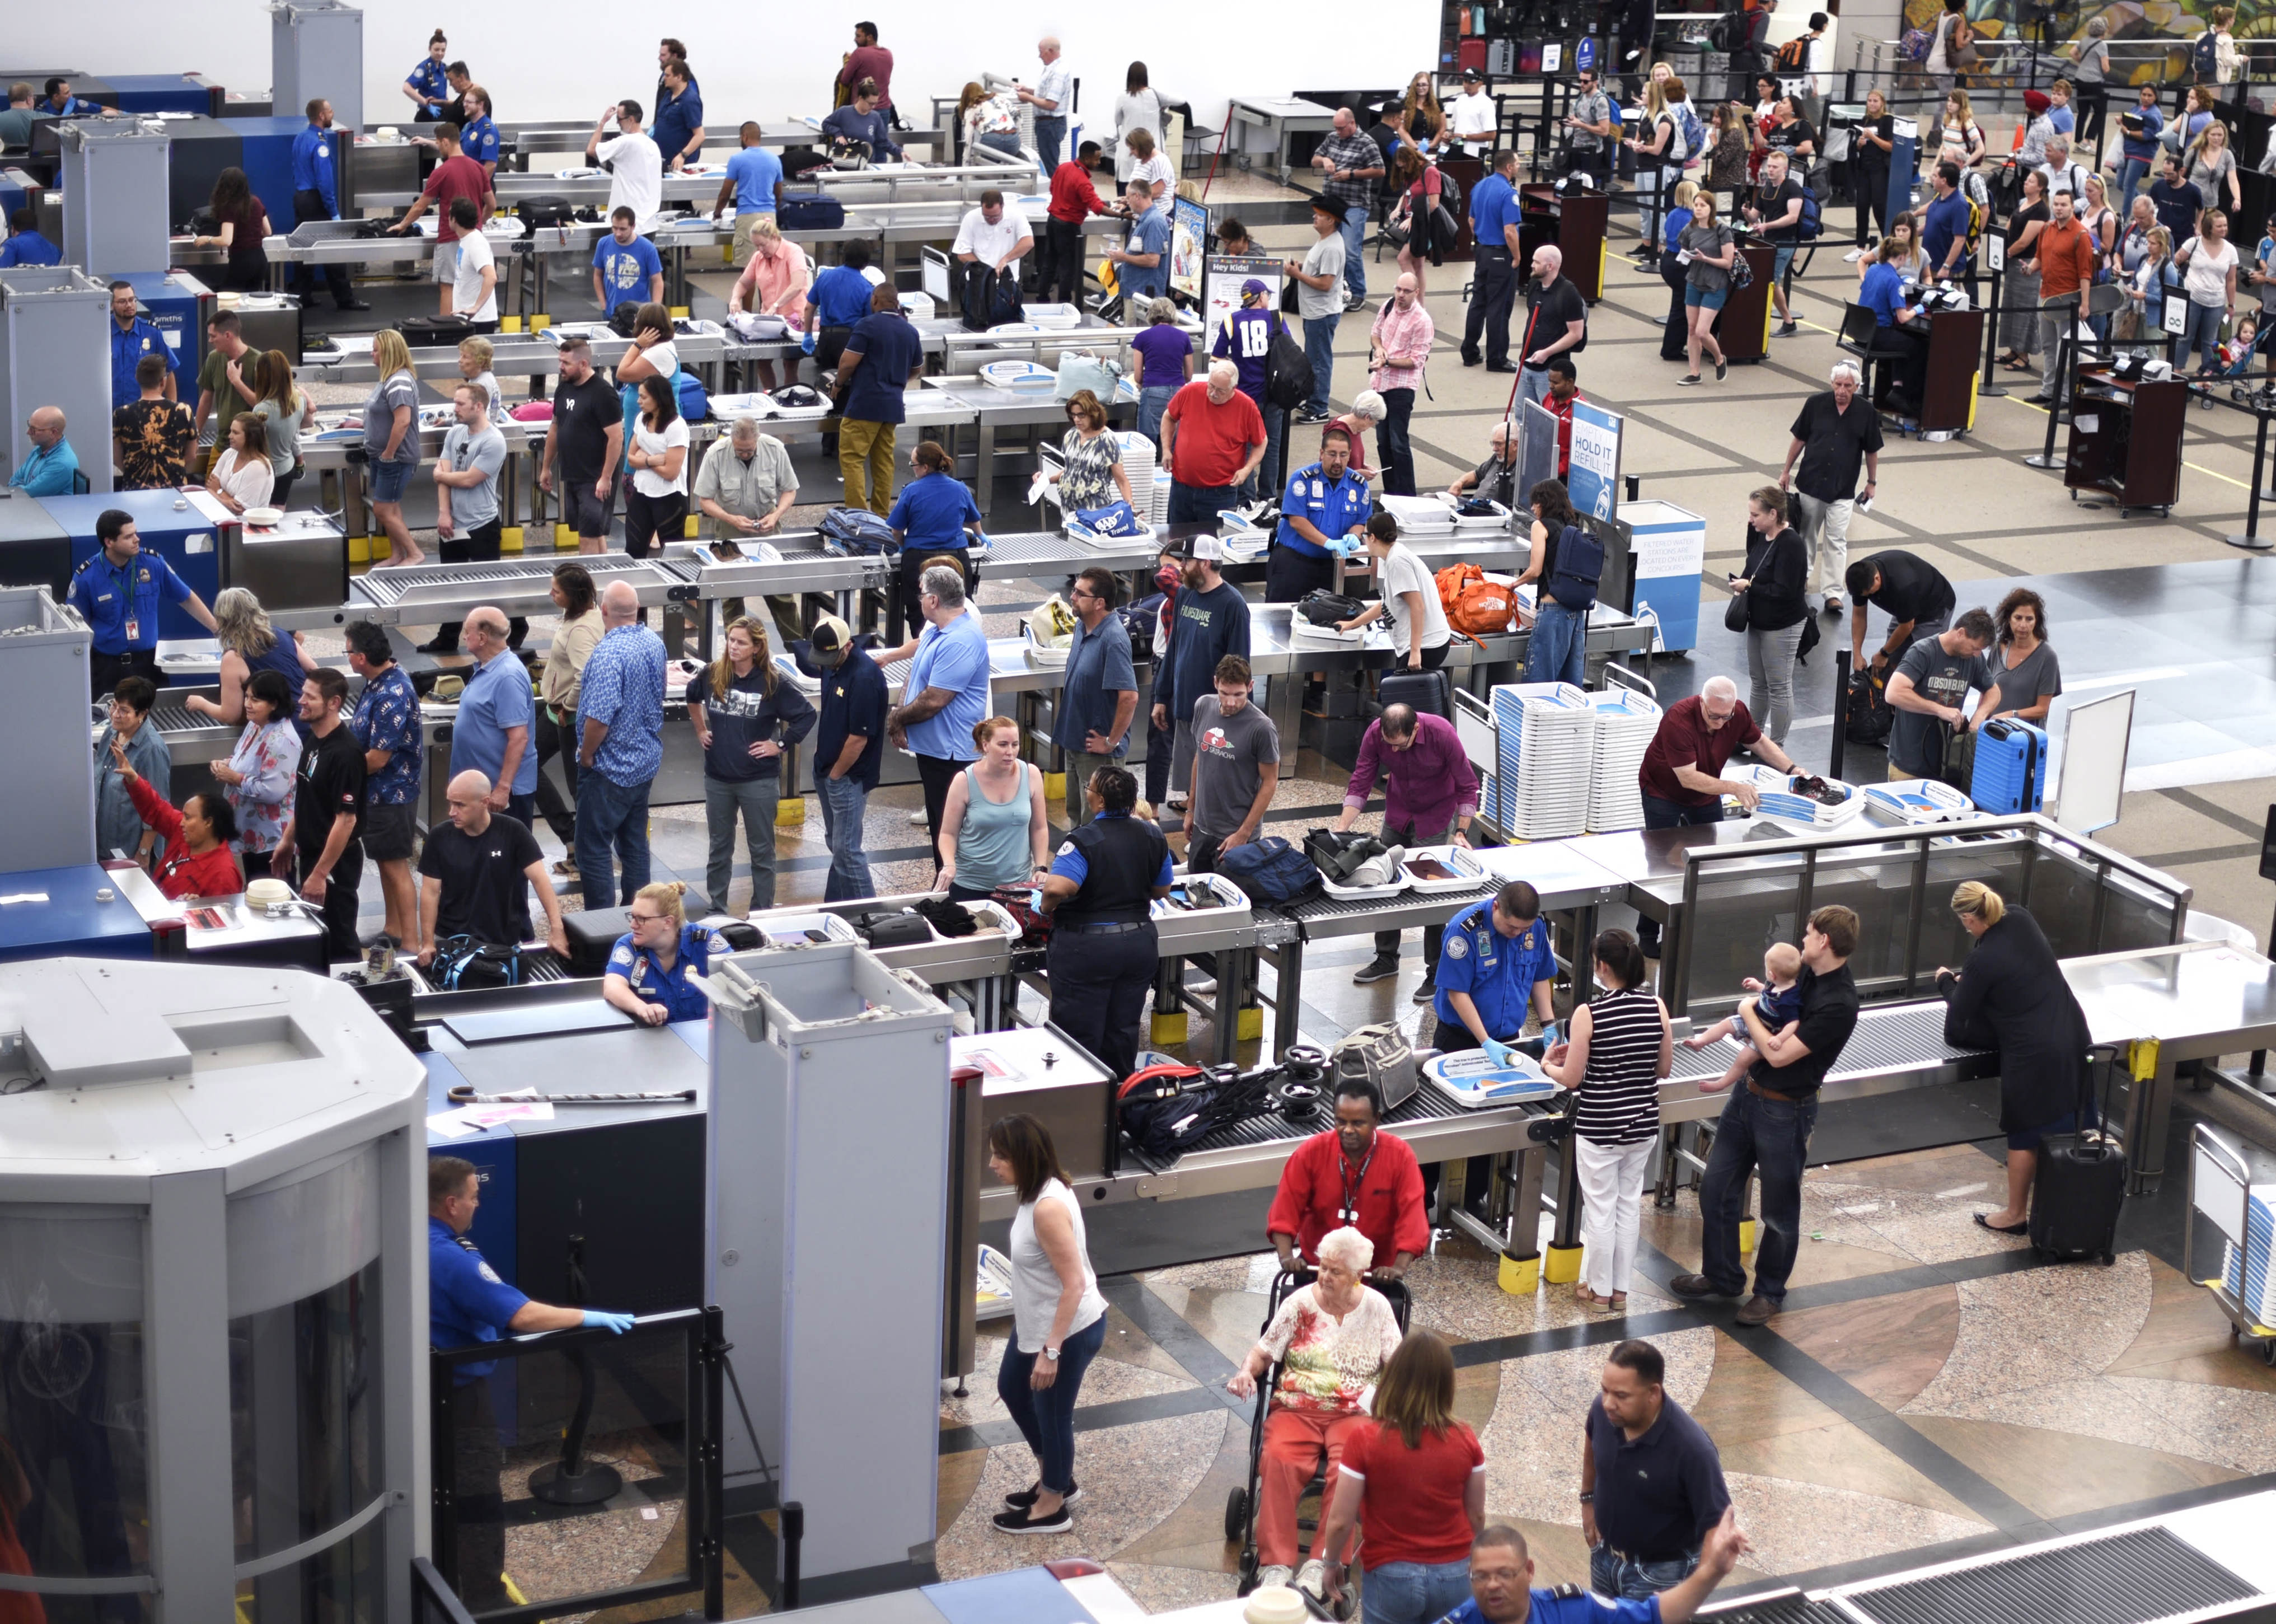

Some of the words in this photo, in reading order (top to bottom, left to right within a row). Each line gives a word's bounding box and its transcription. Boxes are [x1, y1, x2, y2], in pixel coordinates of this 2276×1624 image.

[1213, 264, 1228, 272] Hey
[1239, 320, 1268, 358] 18
[1576, 422, 1603, 442] EMPTY
[1575, 435, 1601, 456] HOLD
[1603, 447, 1612, 461] IT
[1574, 450, 1601, 471] REFILL
[1603, 462, 1611, 474] IT
[1097, 518, 1117, 530] AAA
[1111, 523, 1129, 536] Travel
[1643, 539, 1672, 547] FILTERED
[1647, 548, 1676, 556] STATIONS
[1638, 556, 1667, 565] LOCATED
[1209, 746, 1235, 761] SRIRACHA
